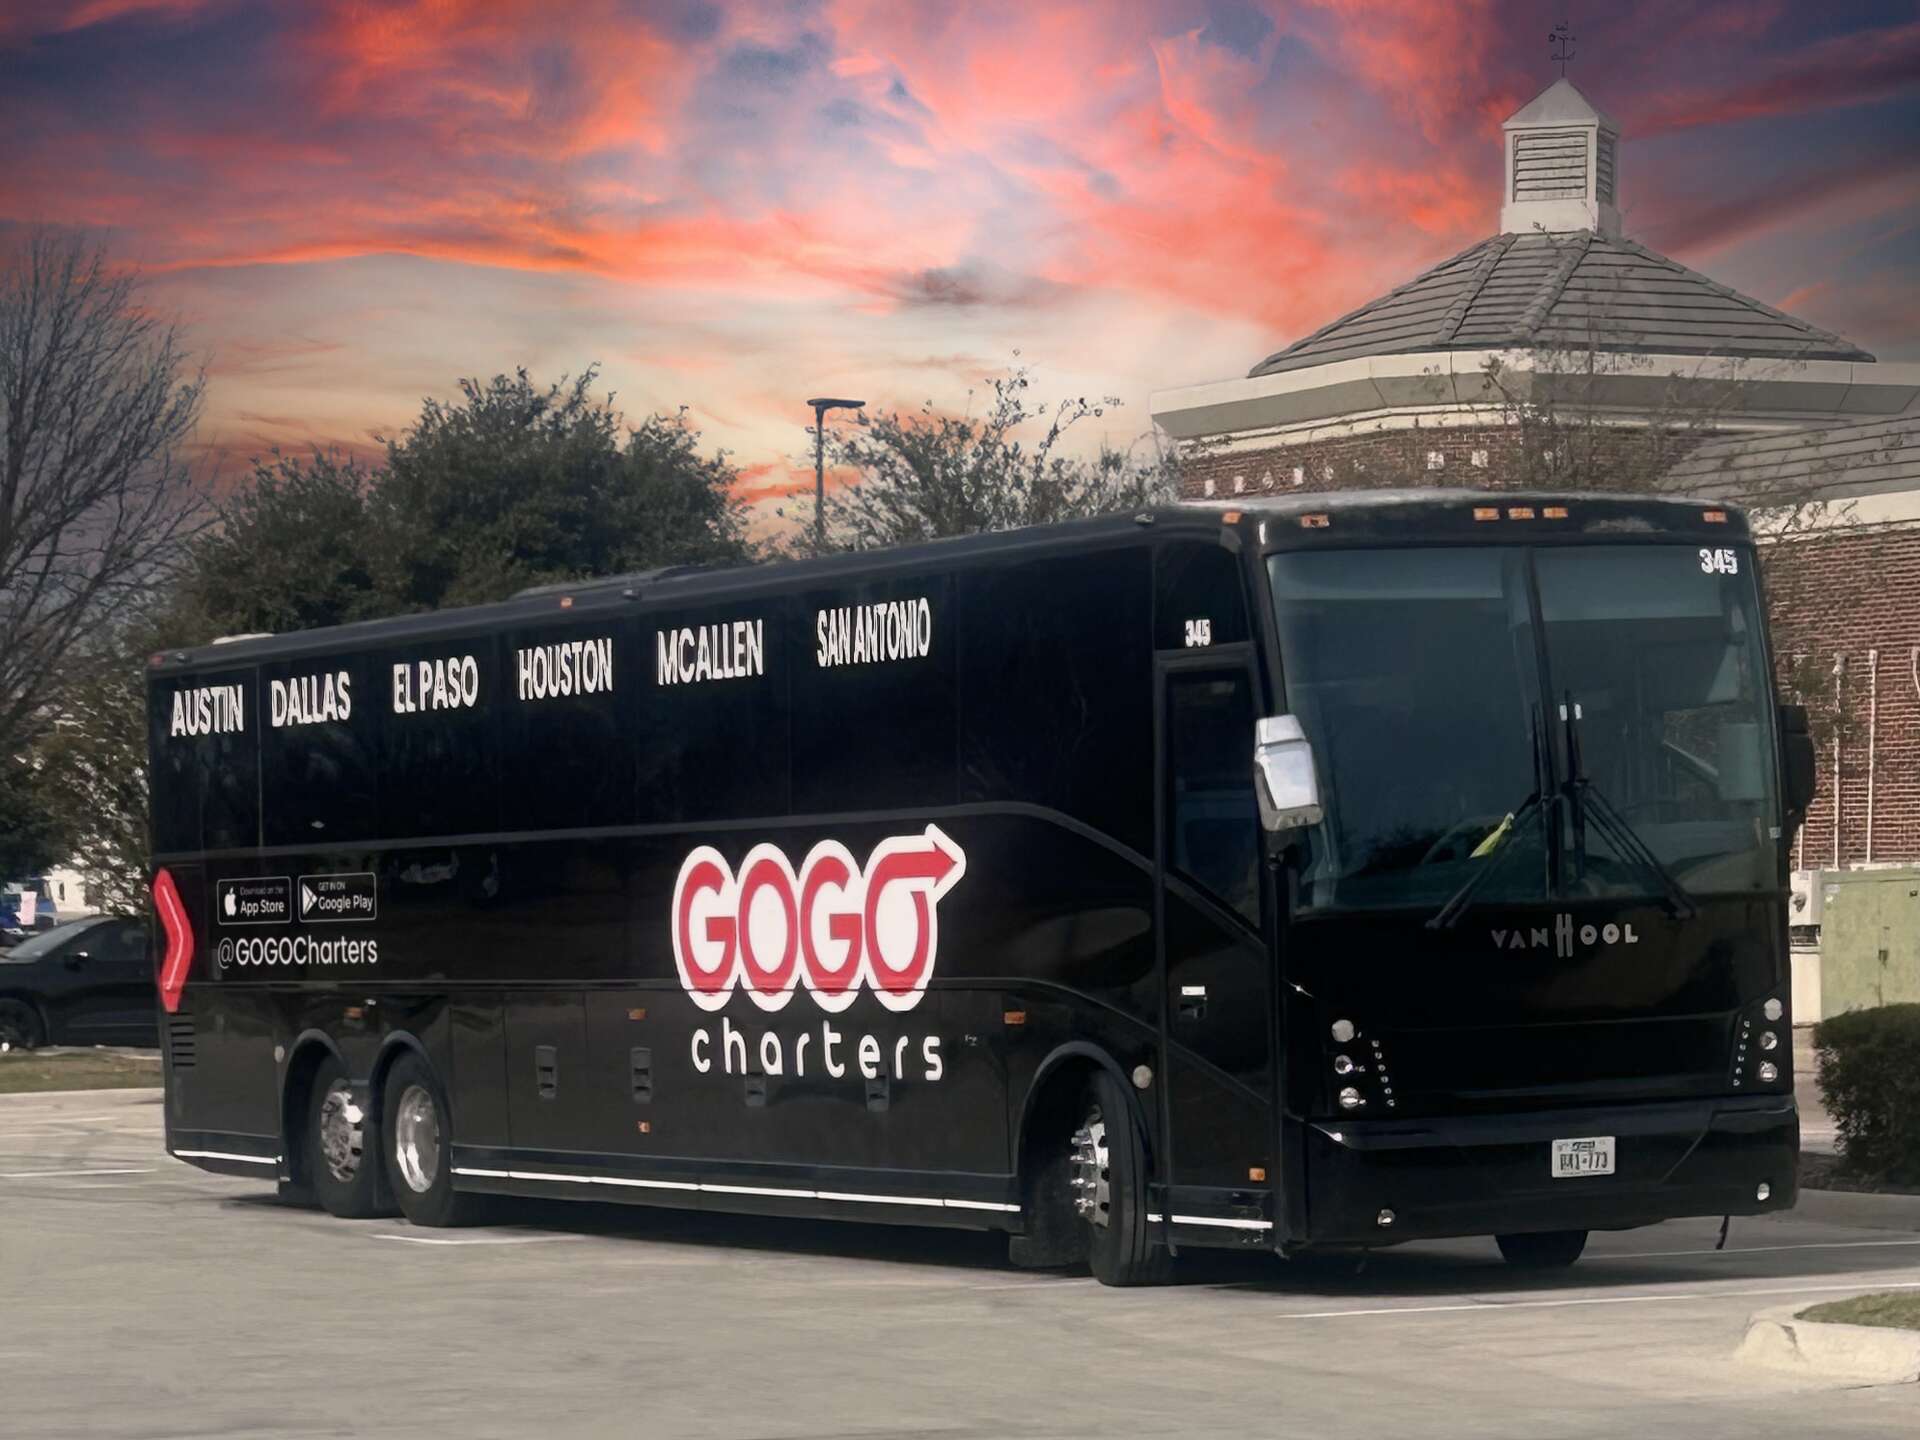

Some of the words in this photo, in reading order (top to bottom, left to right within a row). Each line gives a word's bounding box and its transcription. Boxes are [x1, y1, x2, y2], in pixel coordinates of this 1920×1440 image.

[1699, 548, 1738, 575] 345
[657, 618, 764, 686] MCALLEN
[816, 607, 851, 667] SAN
[853, 597, 931, 664] ANTONIO
[1185, 618, 1211, 648] 345
[392, 663, 416, 714] EL
[419, 655, 479, 711] PASO
[517, 637, 613, 701] HOUSTON
[170, 684, 244, 737] AUSTIN
[270, 671, 351, 728] DALLAS
[240, 900, 259, 917] App
[260, 899, 284, 913] Store
[318, 894, 351, 913] Google
[352, 894, 373, 912] Play
[672, 823, 967, 1013] GOGO
[217, 934, 378, 969] @GOGOCharters
[691, 1016, 943, 1081] charters
